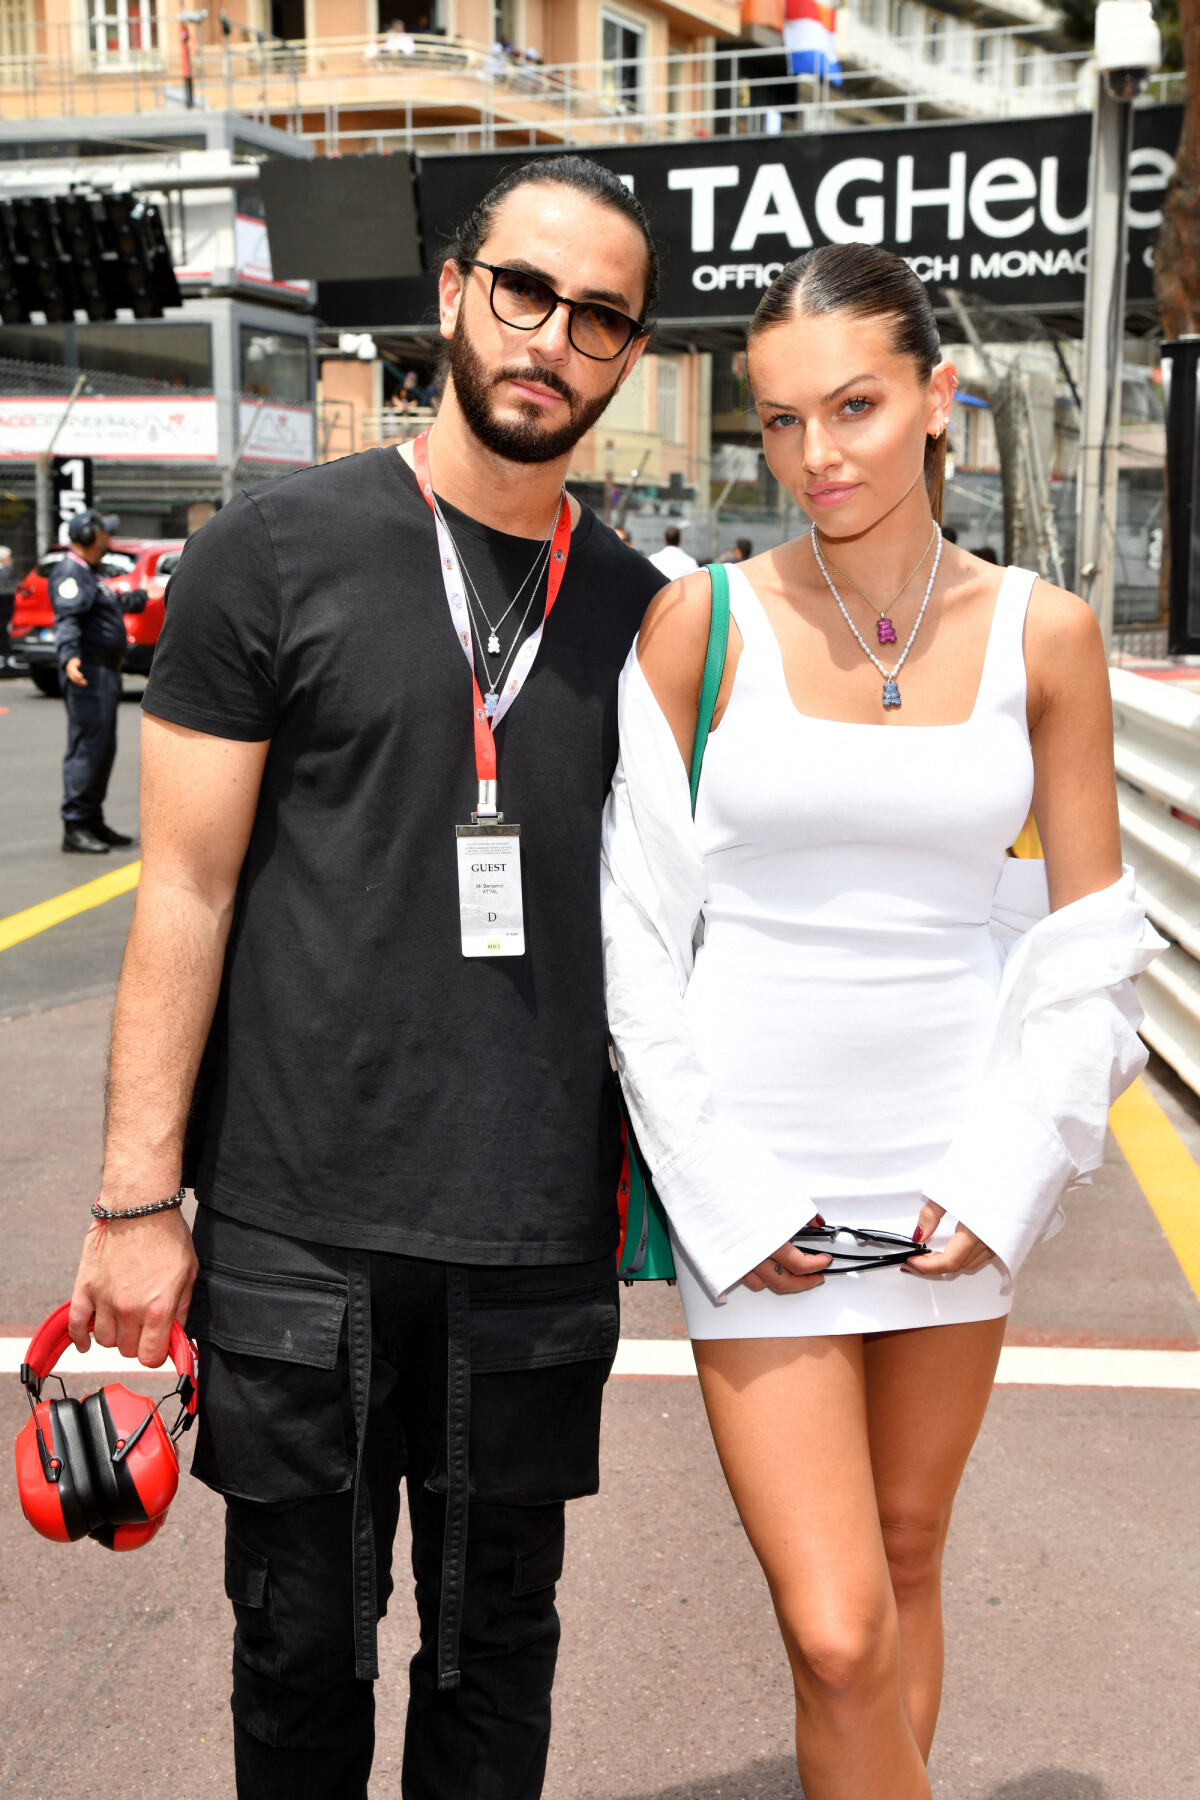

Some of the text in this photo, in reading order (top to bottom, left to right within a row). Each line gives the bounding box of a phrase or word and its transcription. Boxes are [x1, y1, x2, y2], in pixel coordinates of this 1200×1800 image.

[692, 262, 784, 291] OFFIC
[970, 246, 1130, 279] MONAC
[471, 863, 507, 873] GUEST
[488, 911, 497, 922] D
